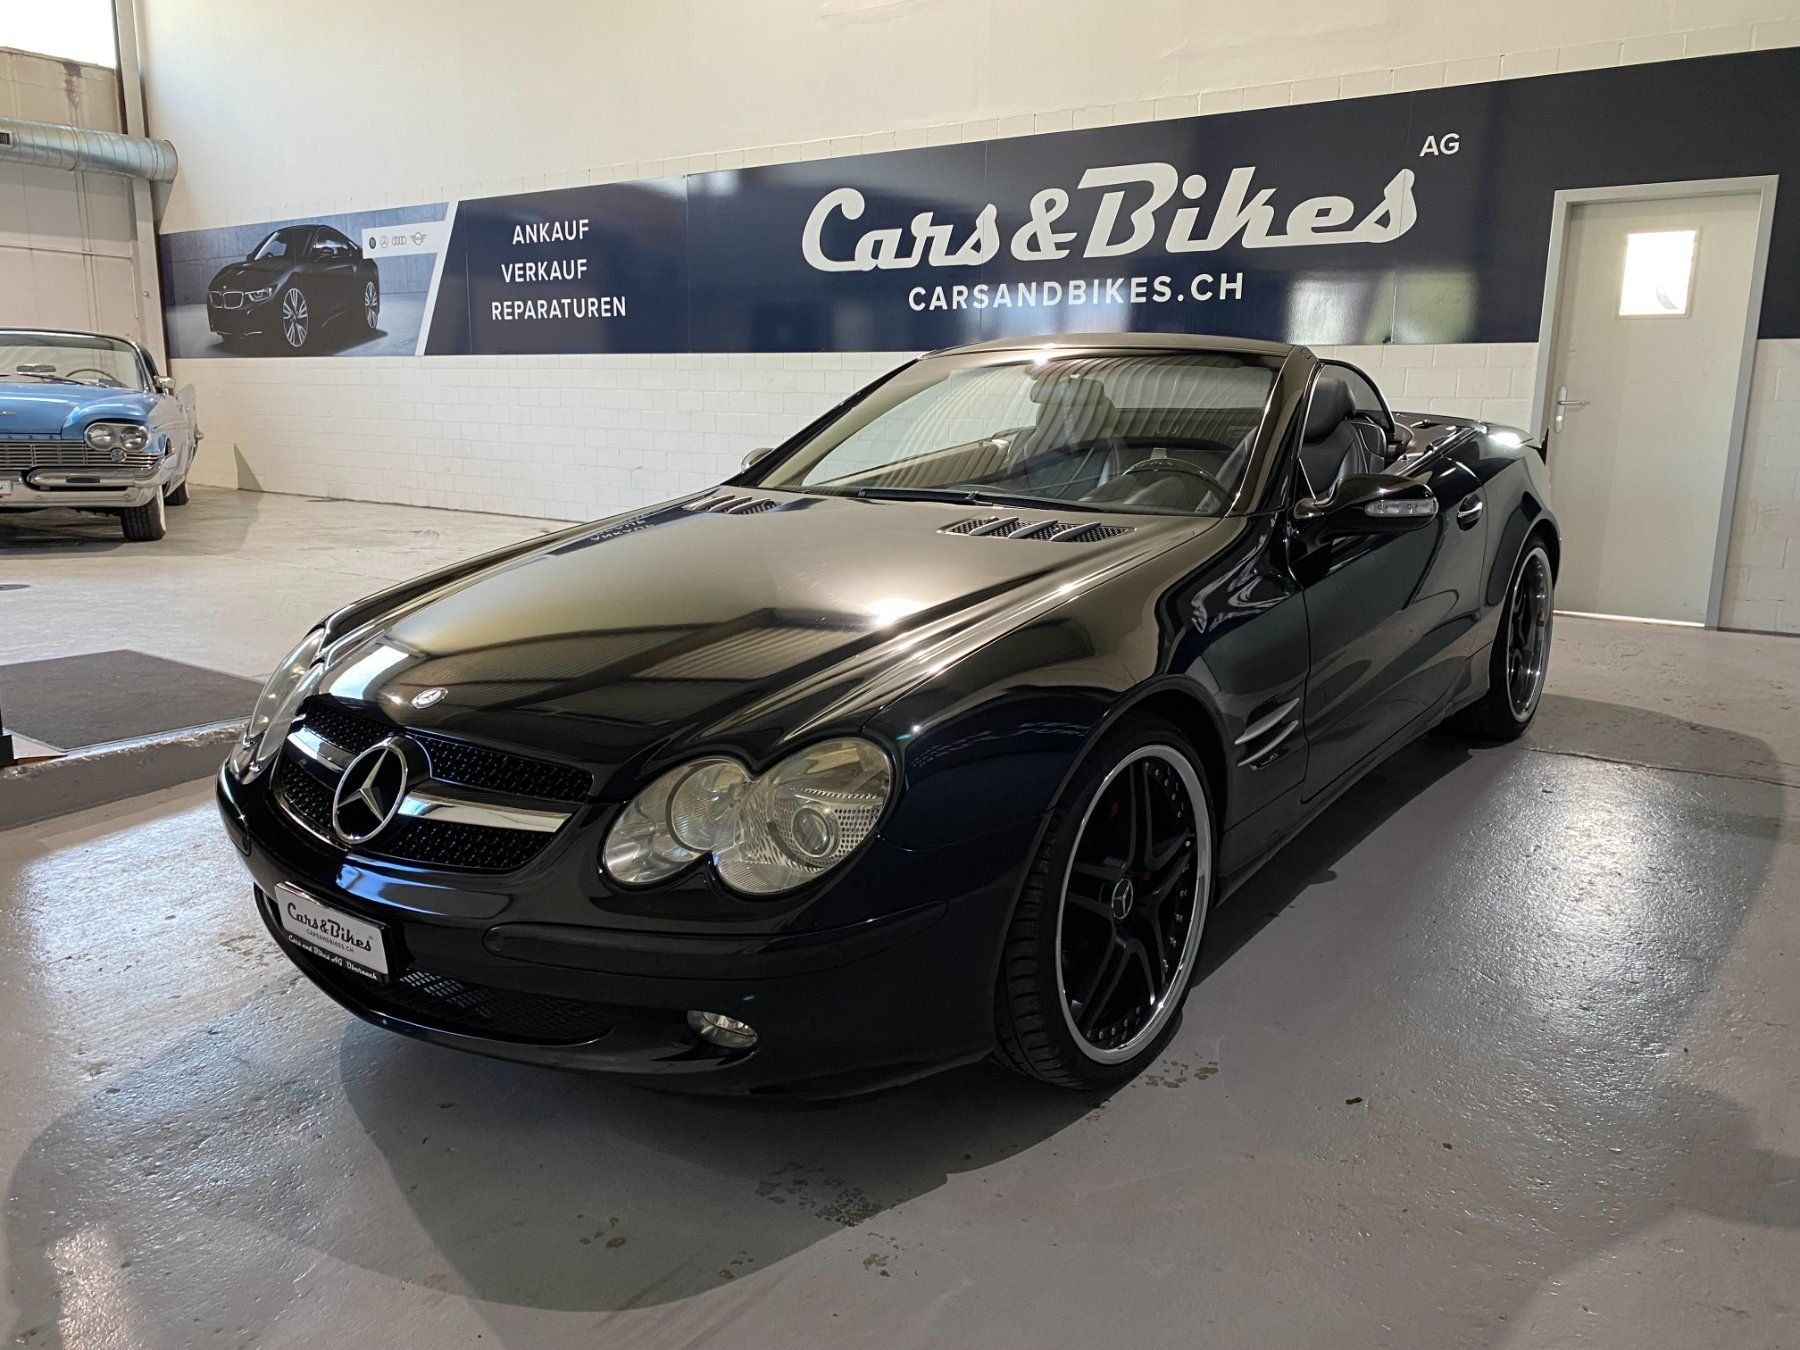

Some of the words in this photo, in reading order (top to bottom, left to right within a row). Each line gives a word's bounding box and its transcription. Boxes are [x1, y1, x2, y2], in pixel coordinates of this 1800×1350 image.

[1419, 132, 1460, 157] AG
[512, 219, 590, 245] ANKAUF
[501, 259, 588, 283] VERKAUF
[908, 272, 1244, 311] CARSANDBIKES.CH
[491, 296, 626, 321] REPARATUREN
[287, 902, 372, 952] Cars&Bikes
